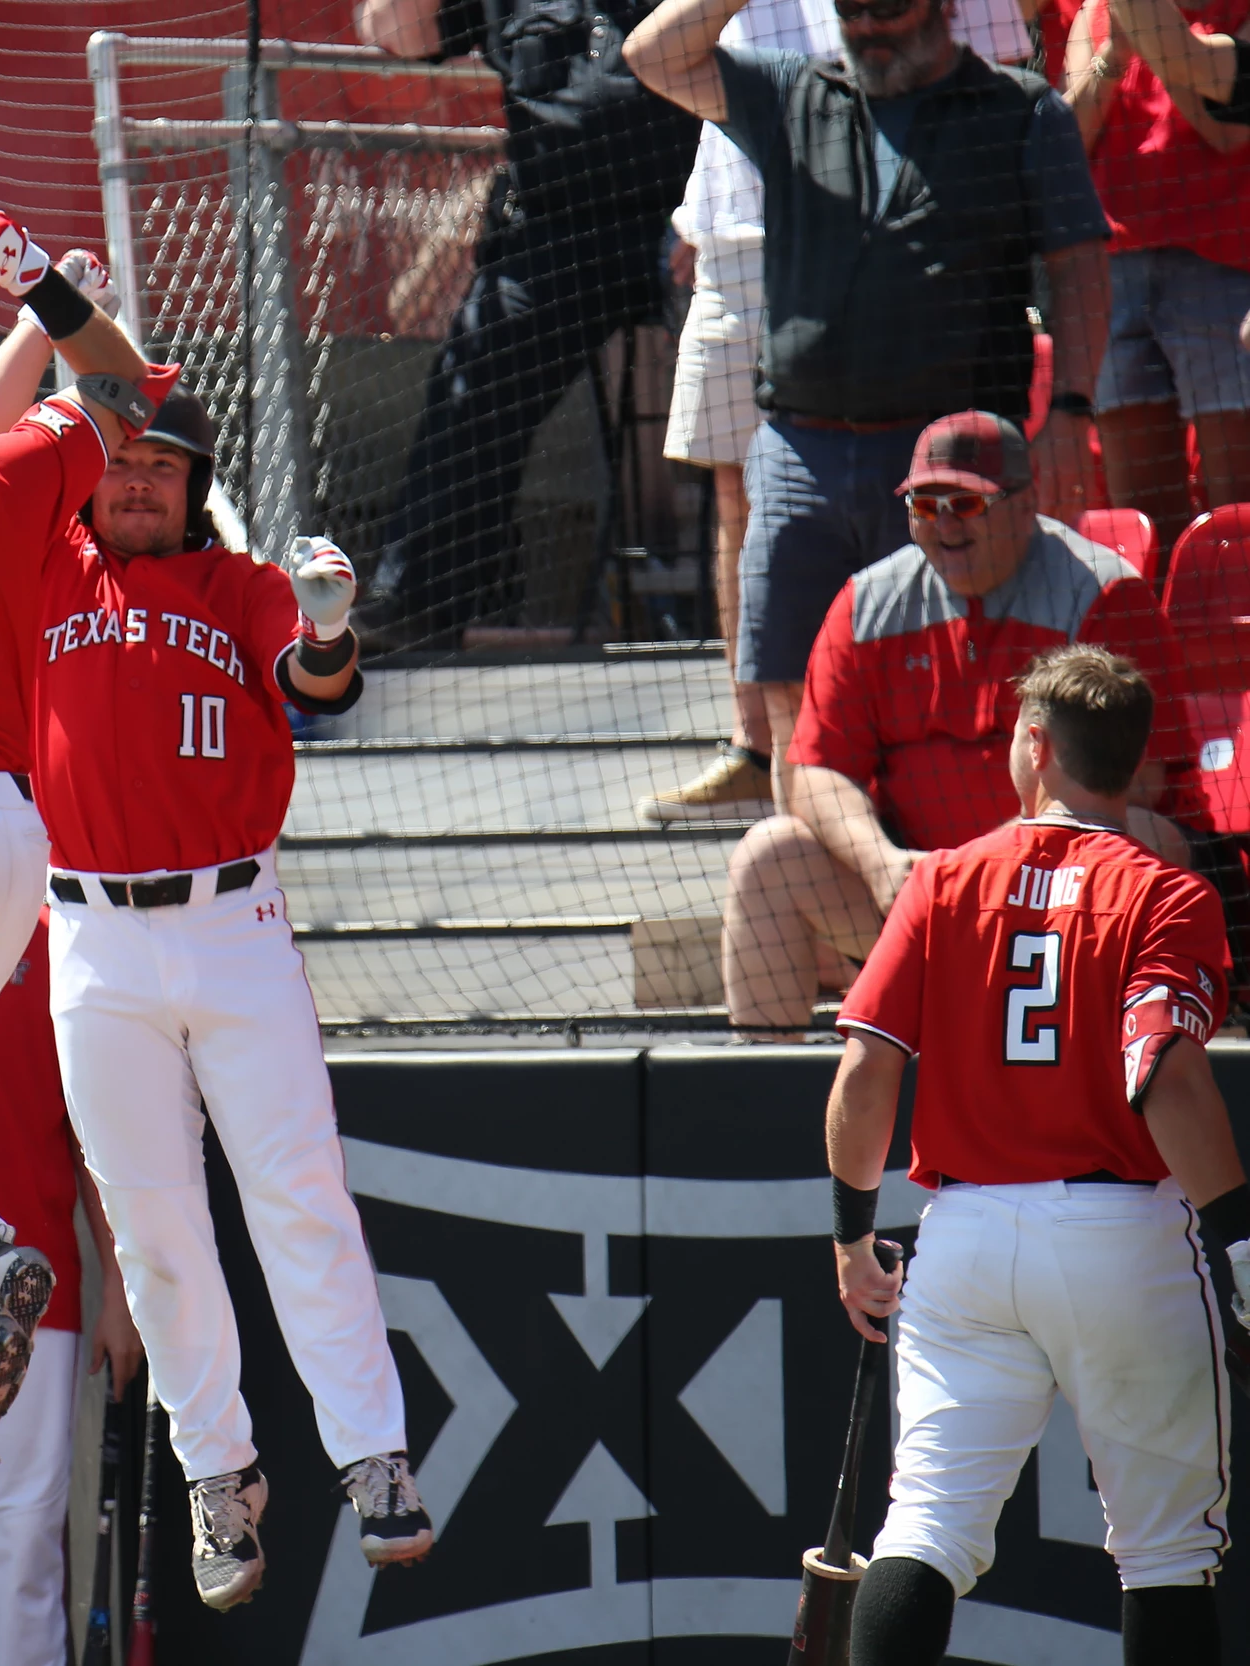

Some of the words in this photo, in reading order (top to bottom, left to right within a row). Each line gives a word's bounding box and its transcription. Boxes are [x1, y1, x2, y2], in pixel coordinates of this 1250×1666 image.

[44, 607, 148, 663] TEXAS
[161, 612, 245, 686] TECH
[178, 693, 226, 759] 10
[1007, 864, 1086, 911] JUNG
[1003, 930, 1063, 1067] 2
